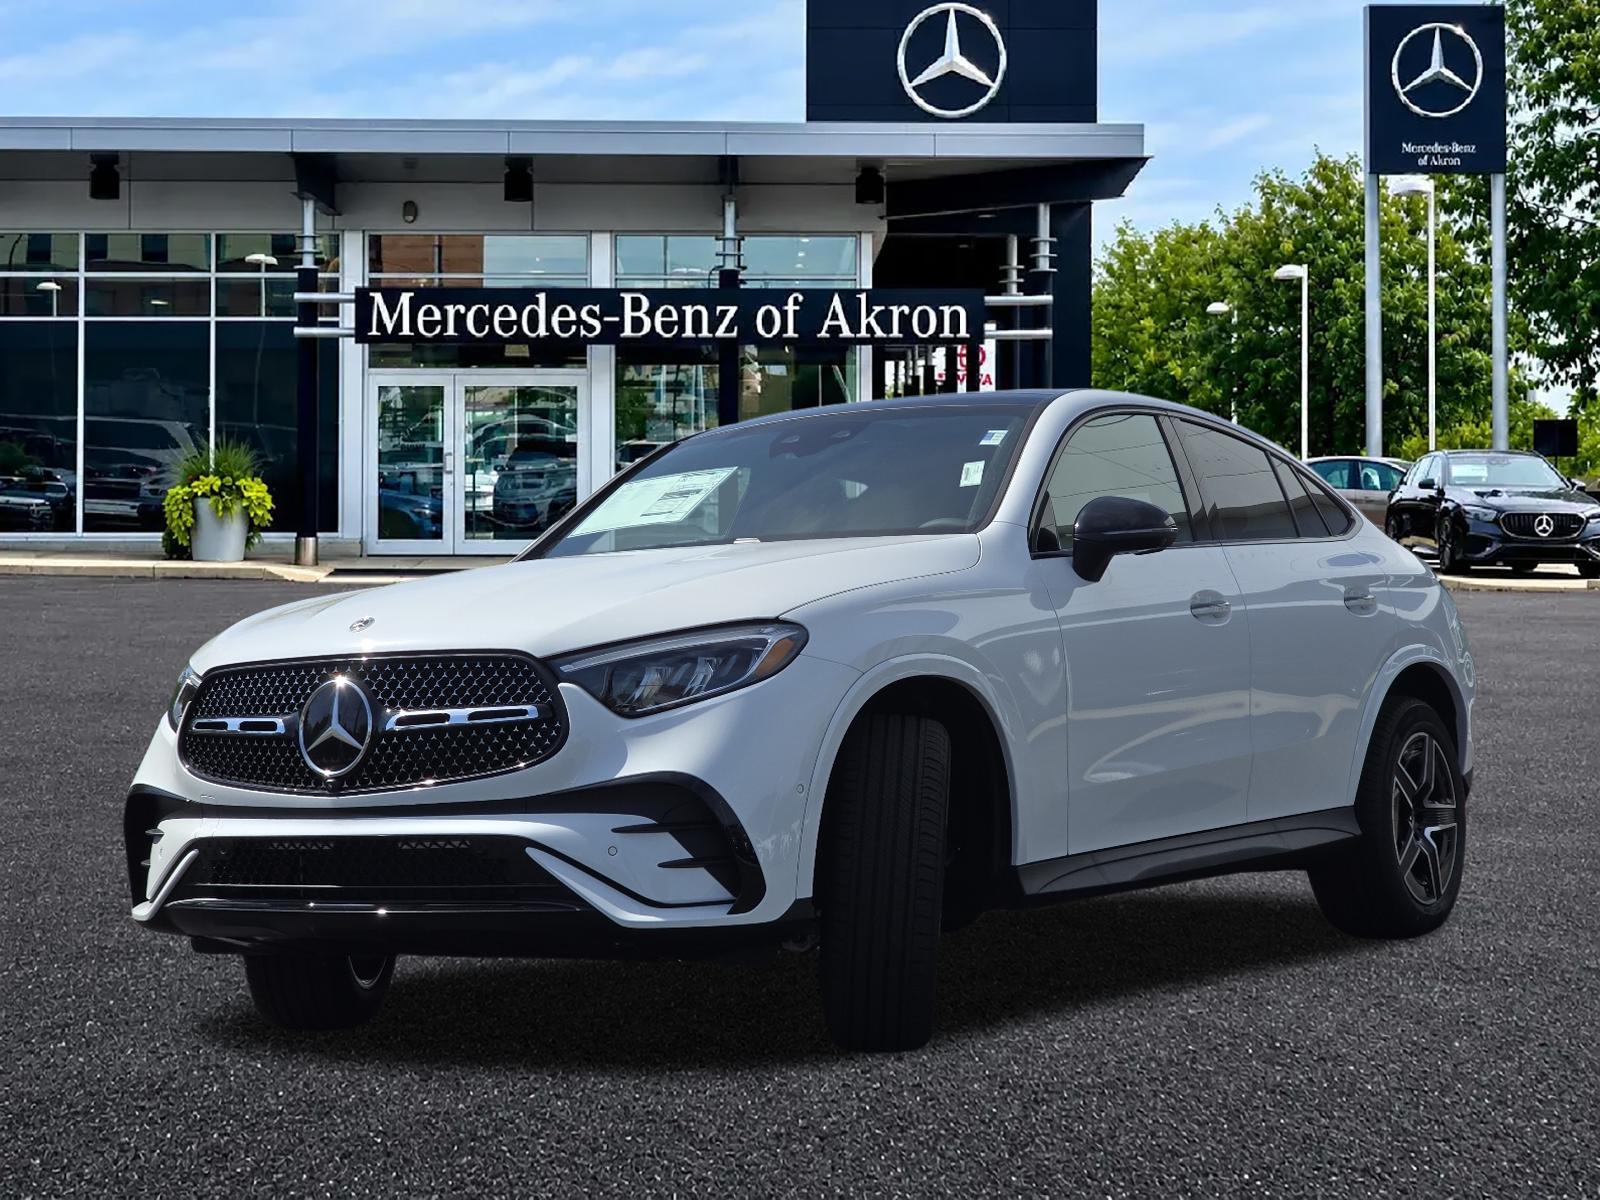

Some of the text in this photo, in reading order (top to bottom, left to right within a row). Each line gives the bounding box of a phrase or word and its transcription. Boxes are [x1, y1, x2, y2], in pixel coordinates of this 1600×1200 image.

[1401, 141, 1477, 154] Mercedes-Benz
[1417, 154, 1461, 166] of Akron
[367, 291, 971, 338] Mercedes-Benz of Akron
